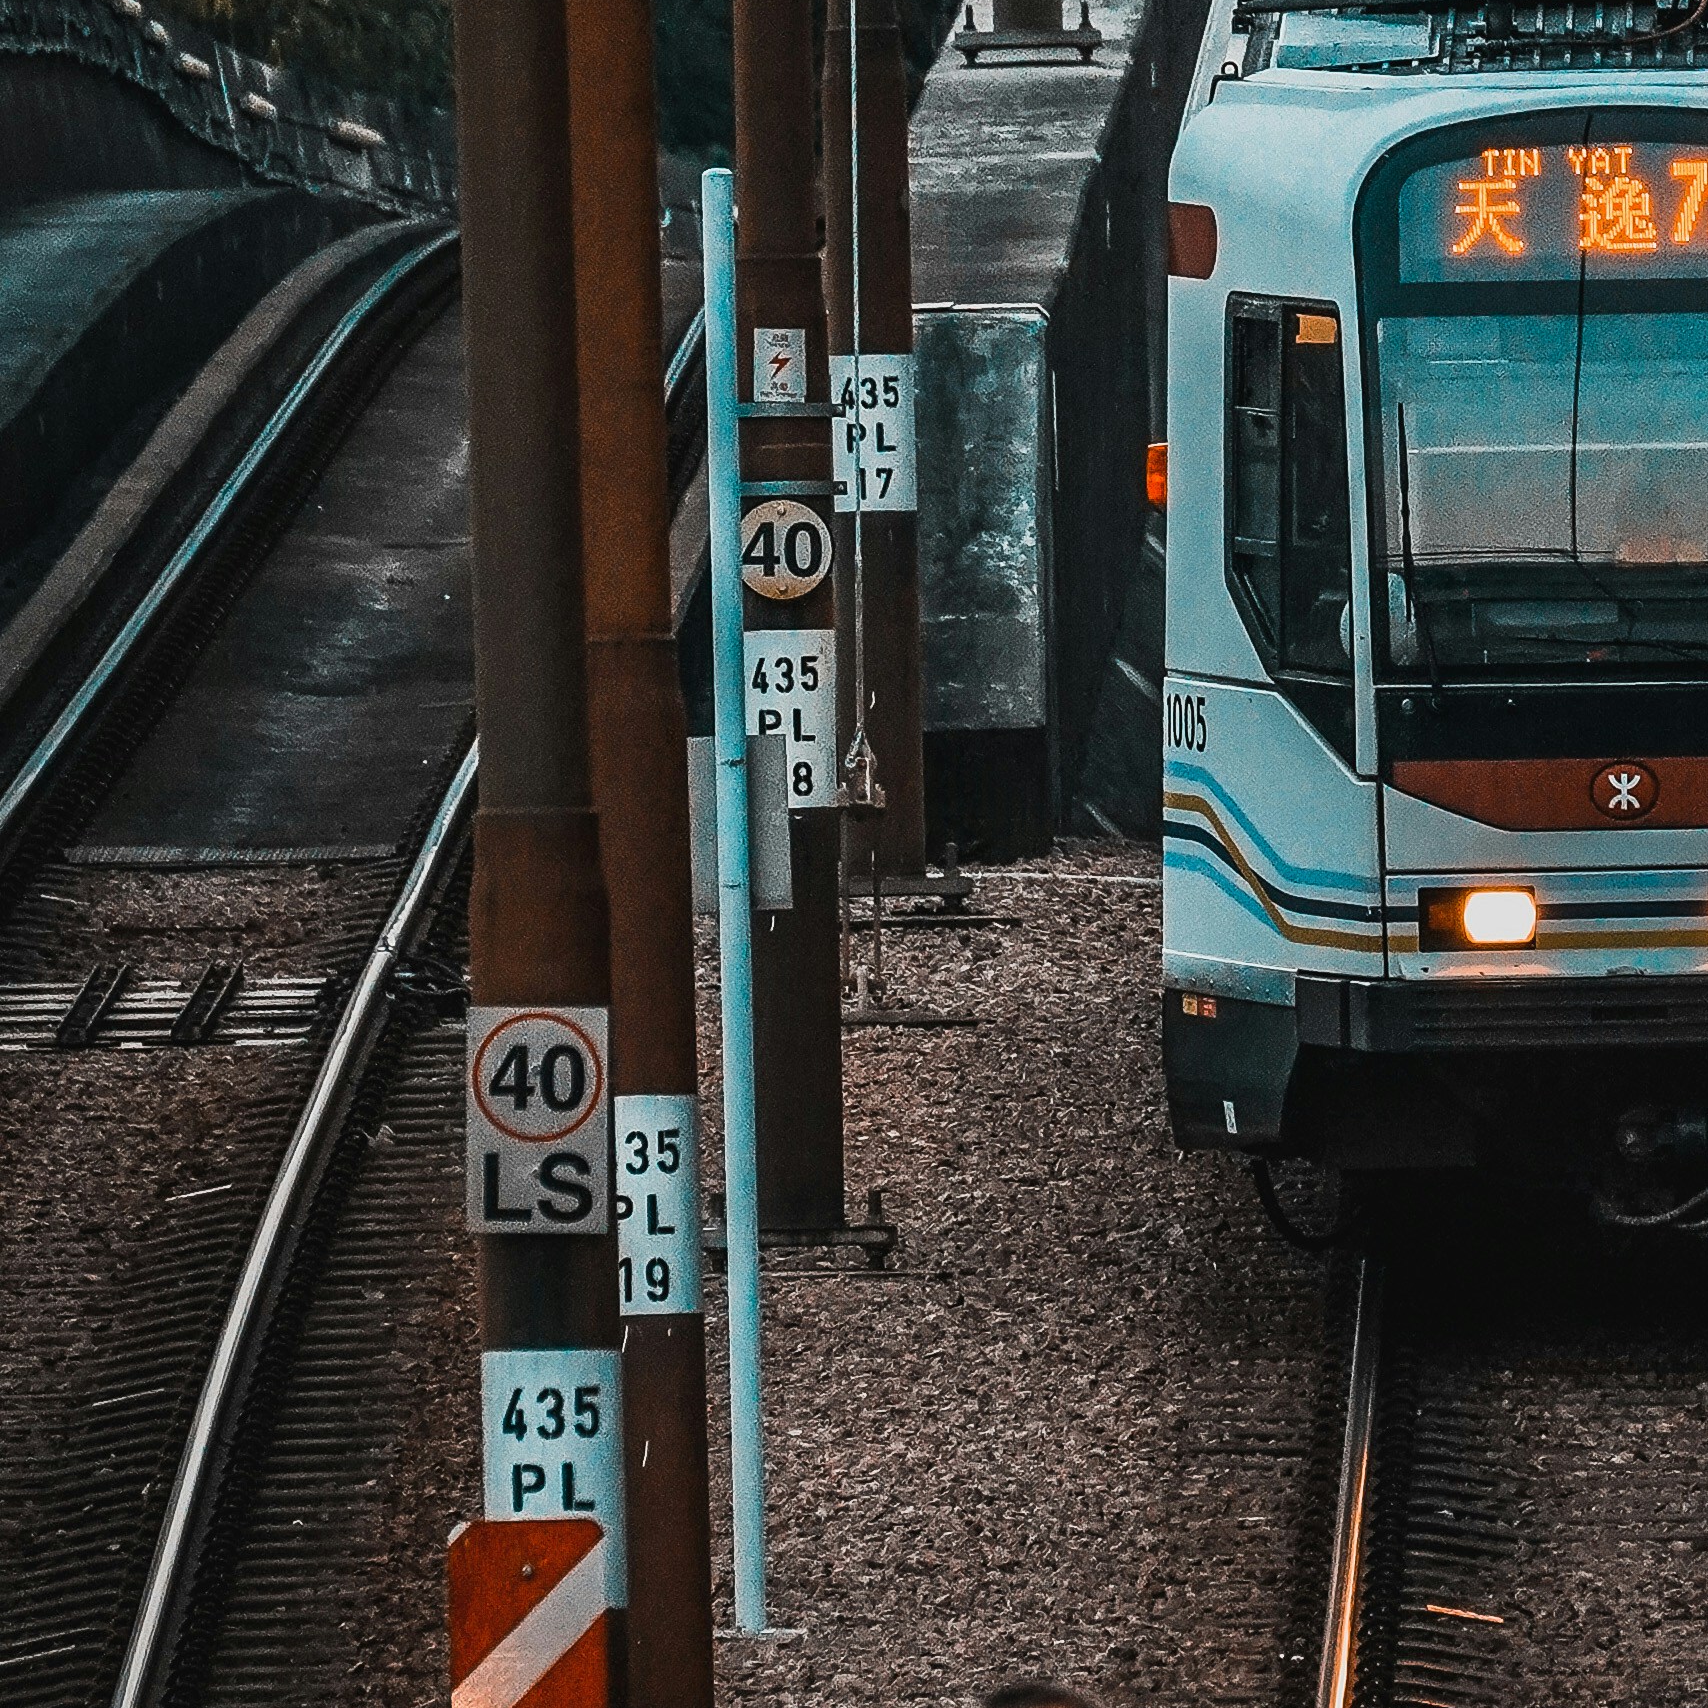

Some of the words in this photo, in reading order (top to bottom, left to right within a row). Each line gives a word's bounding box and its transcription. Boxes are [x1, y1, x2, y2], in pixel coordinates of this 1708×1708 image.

[1481, 148, 1539, 176] TIN
[1568, 146, 1634, 174] YAT
[840, 375, 900, 409] 435
[845, 422, 897, 454] PL
[857, 468, 894, 500] 17
[741, 520, 824, 579] 40
[751, 656, 820, 693] 435
[1167, 693, 1207, 753] 1005
[488, 1043, 585, 1113] 40
[625, 1128, 681, 1176] 35
[482, 1151, 593, 1224] LS
[502, 1388, 601, 1442] 435
[511, 1462, 595, 1513] PL
